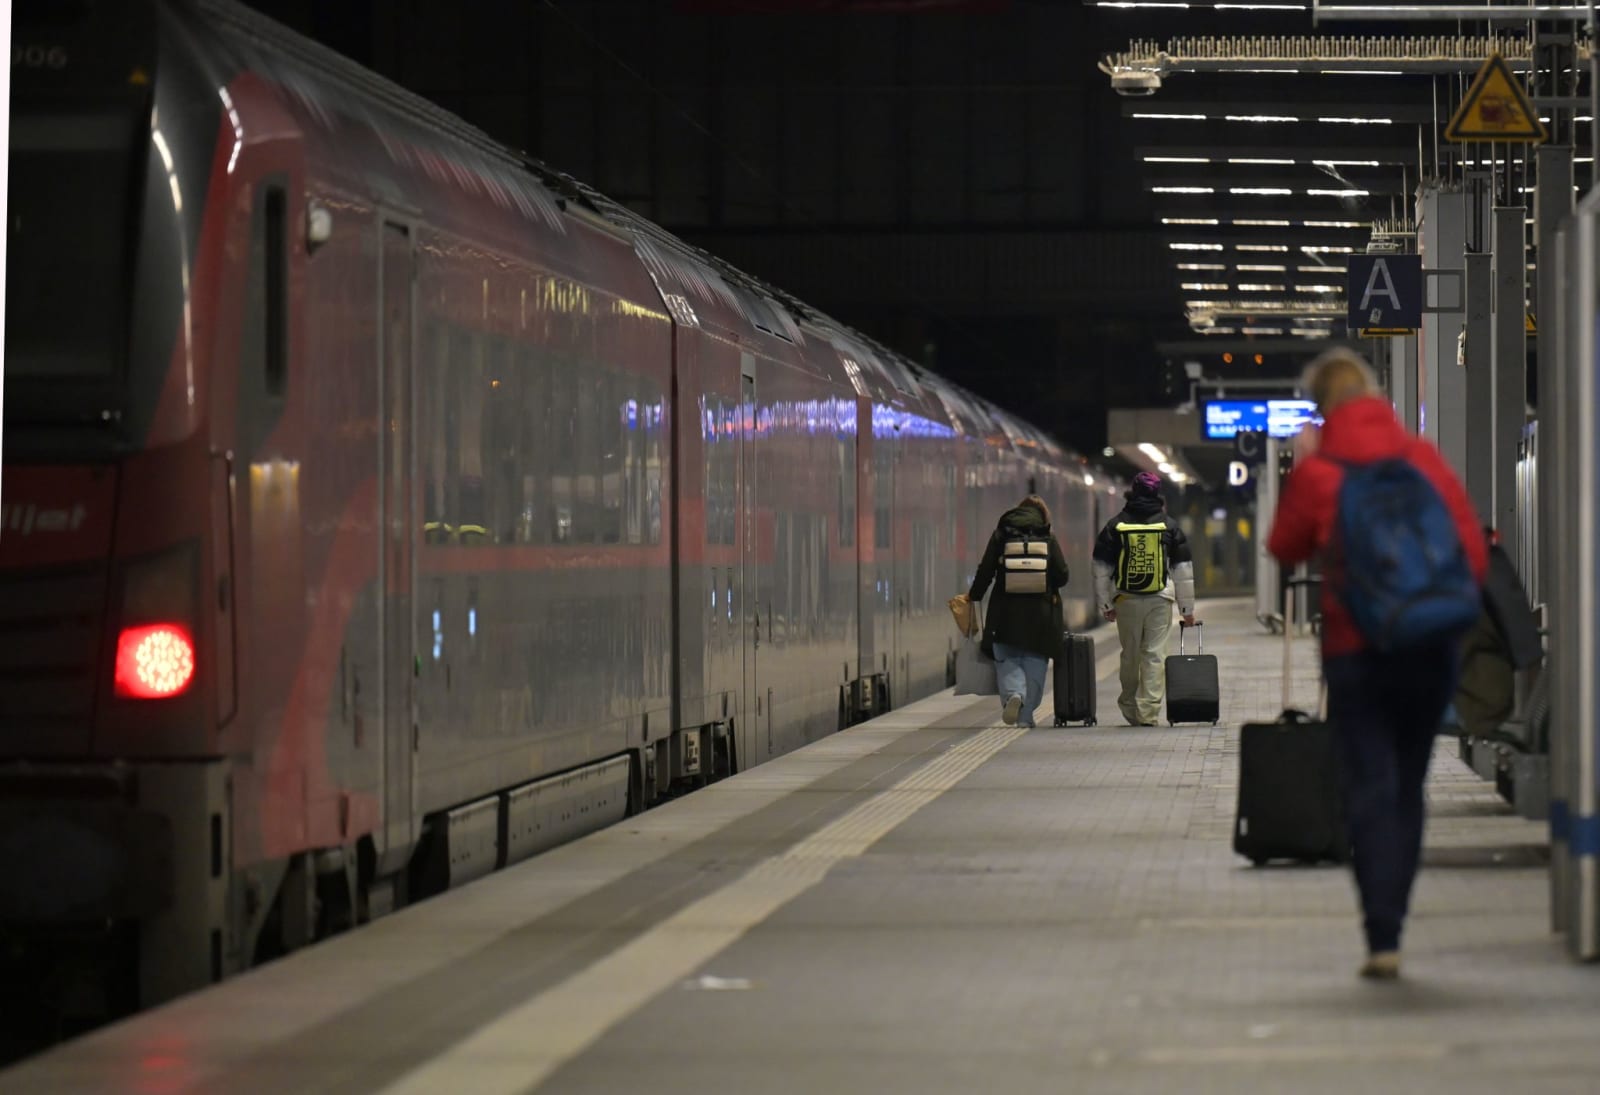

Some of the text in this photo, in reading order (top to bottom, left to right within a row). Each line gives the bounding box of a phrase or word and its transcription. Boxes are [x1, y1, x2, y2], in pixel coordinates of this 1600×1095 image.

[1359, 258, 1401, 311] A
[1238, 432, 1259, 458] C
[1229, 461, 1249, 486] D
[1129, 546, 1137, 572] FACE
[1137, 535, 1145, 573] NORTH
[1146, 552, 1154, 573] THE
